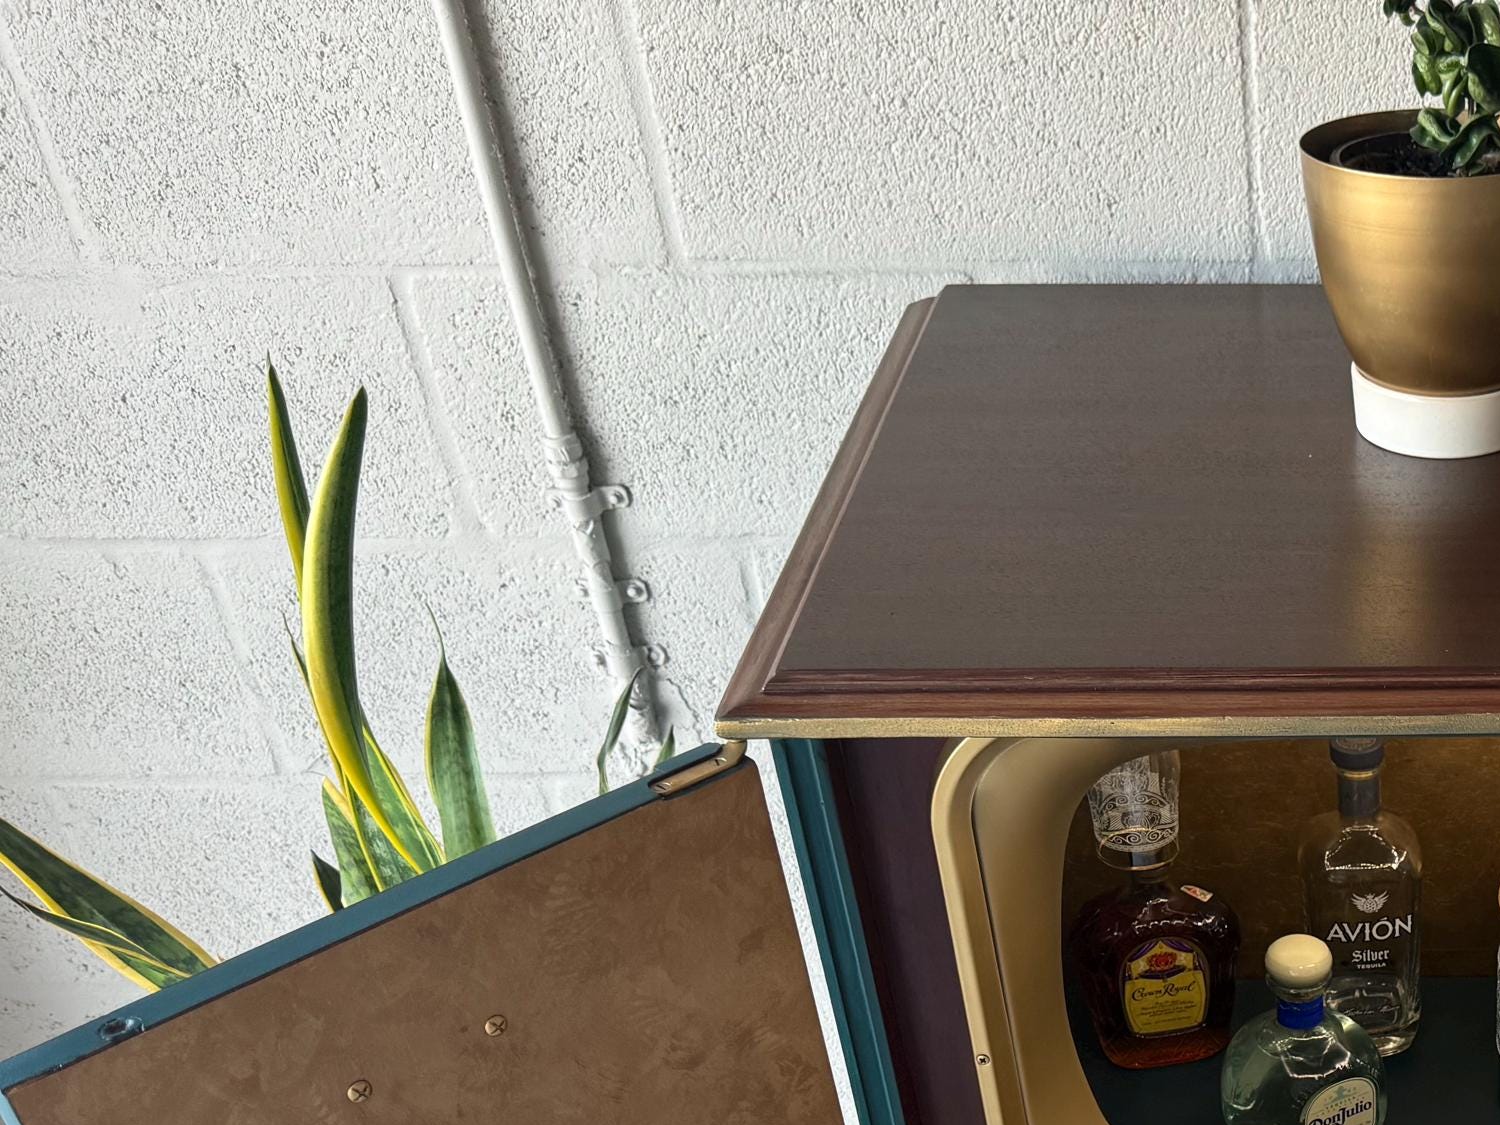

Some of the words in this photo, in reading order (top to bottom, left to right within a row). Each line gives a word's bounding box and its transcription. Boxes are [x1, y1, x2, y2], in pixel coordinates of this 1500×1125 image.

[1326, 914, 1412, 943] AVIÓN
[1351, 949, 1390, 963] Silver
[1356, 962, 1387, 970] TEQUILA
[1132, 987, 1161, 1002] Crown
[1158, 980, 1197, 998] Royal
